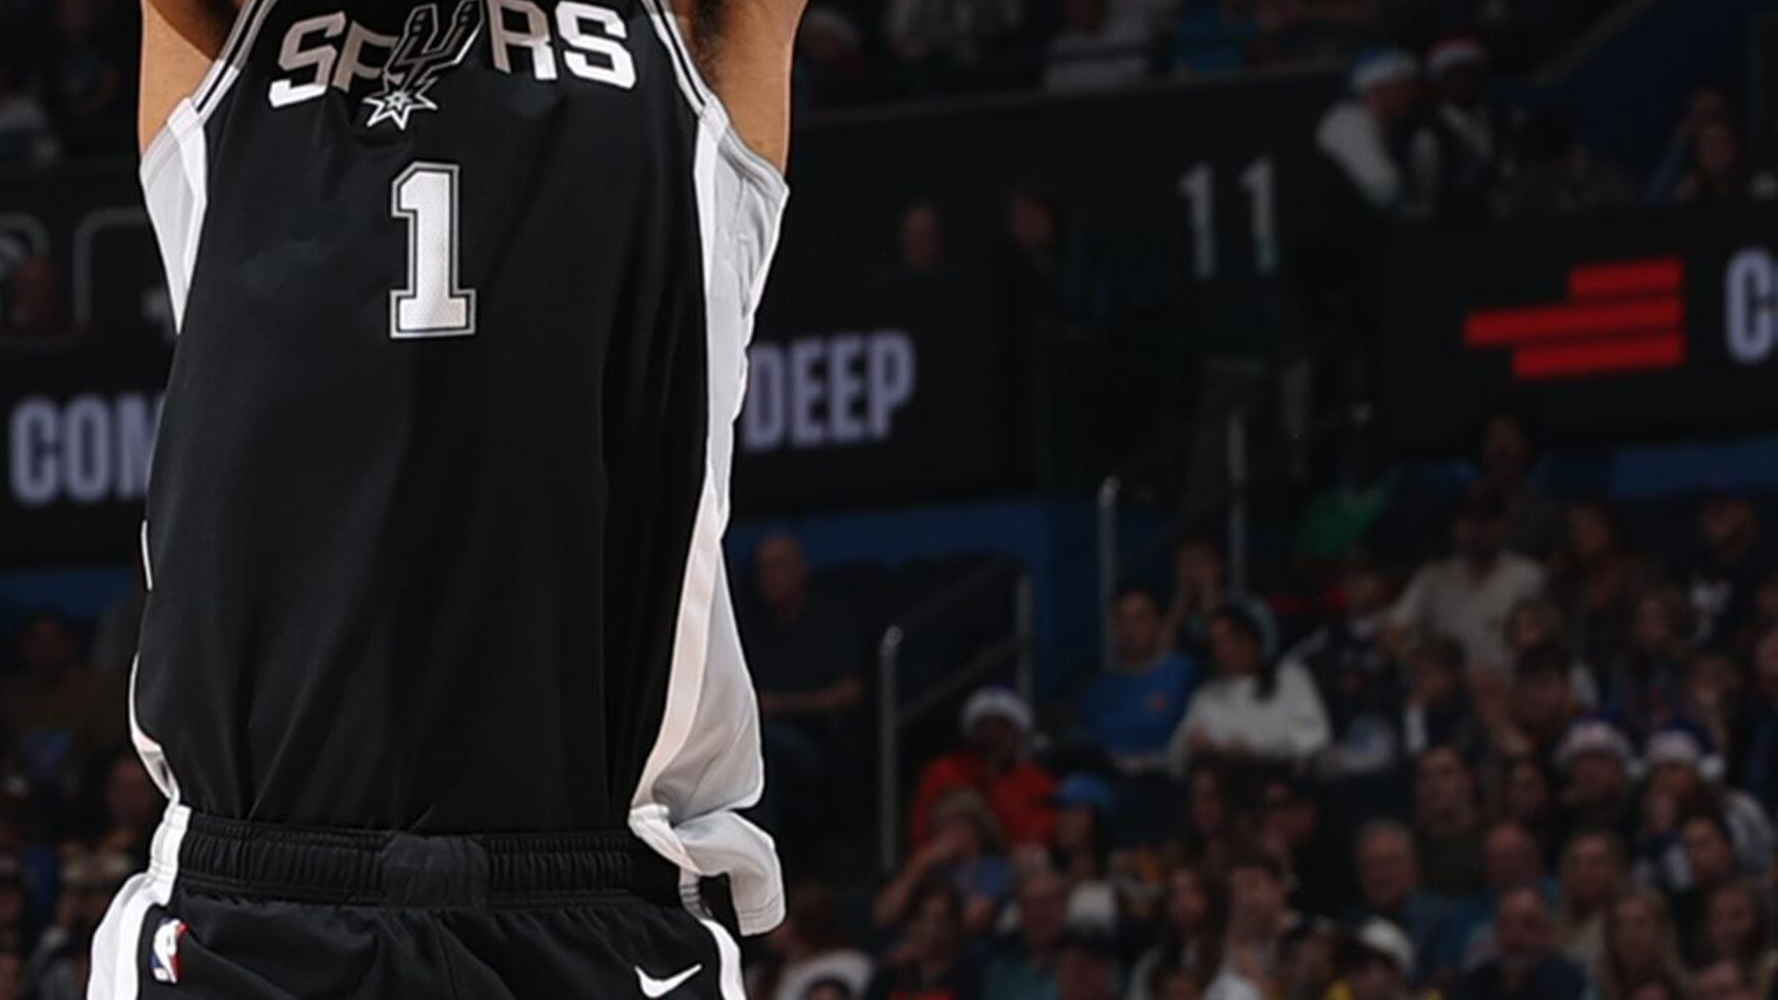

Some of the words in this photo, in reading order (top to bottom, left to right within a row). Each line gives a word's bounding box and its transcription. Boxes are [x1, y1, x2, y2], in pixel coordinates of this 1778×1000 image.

[390, 160, 476, 340] 1
[1724, 247, 1778, 364] C
[744, 333, 914, 449] DEEP
